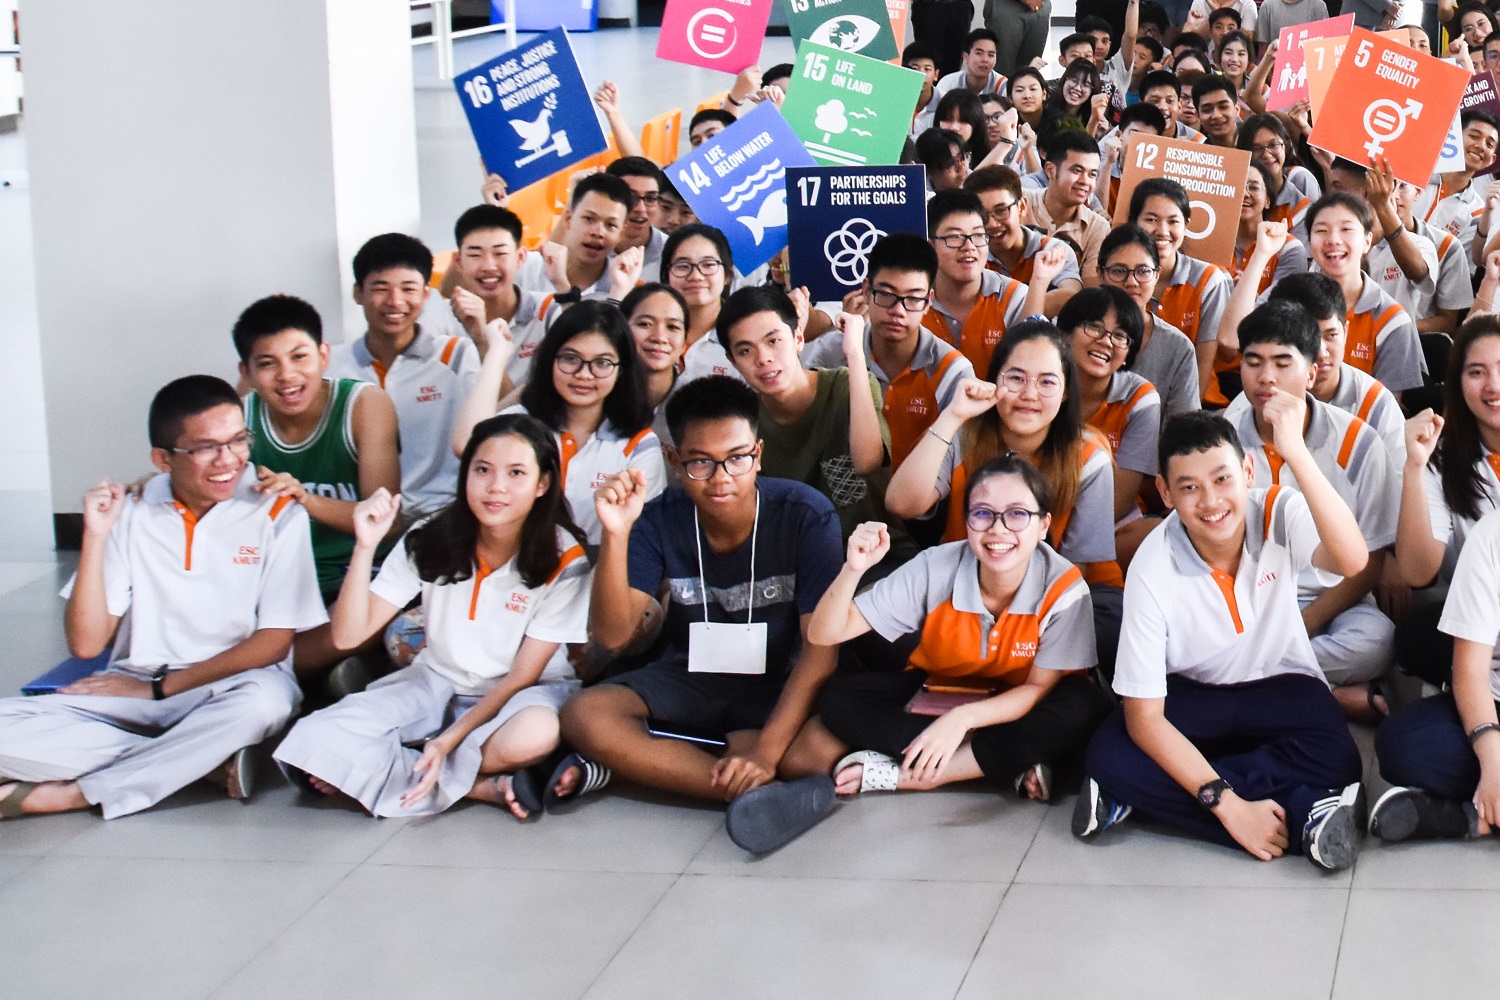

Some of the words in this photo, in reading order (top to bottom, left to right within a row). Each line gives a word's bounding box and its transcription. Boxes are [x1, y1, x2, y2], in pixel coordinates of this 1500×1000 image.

[1286, 32, 1293, 51] 1
[1299, 30, 1308, 39] NO
[521, 40, 558, 68] JUSTICE
[1314, 47, 1325, 71] 7
[1354, 39, 1374, 68] 5
[1381, 49, 1418, 73] GENDER
[803, 52, 830, 82] 15
[835, 58, 856, 74] LIFE
[1375, 64, 1420, 89] EQUALITY
[496, 77, 518, 97] AND
[513, 61, 551, 88] STRONG
[831, 73, 846, 89] ON
[847, 78, 873, 95] LAND
[1473, 79, 1489, 94] AND
[464, 75, 494, 108] 16
[1464, 90, 1495, 108] GROWTH
[704, 144, 727, 165] LIFE
[714, 151, 745, 178] BELOW
[744, 131, 774, 160] WATER
[1136, 142, 1158, 170] 12
[1166, 147, 1224, 168] RESPONSIBLE
[679, 160, 712, 195] 14
[830, 175, 907, 190] PARTNERSHIPS
[1163, 161, 1226, 182] CONSUMPTION
[797, 176, 821, 207] 17
[831, 193, 850, 206] FOR
[851, 192, 871, 205] THE
[872, 191, 907, 205] GOALS
[1180, 178, 1235, 198] PRODUCTION
[1015, 641, 1037, 650] ESC
